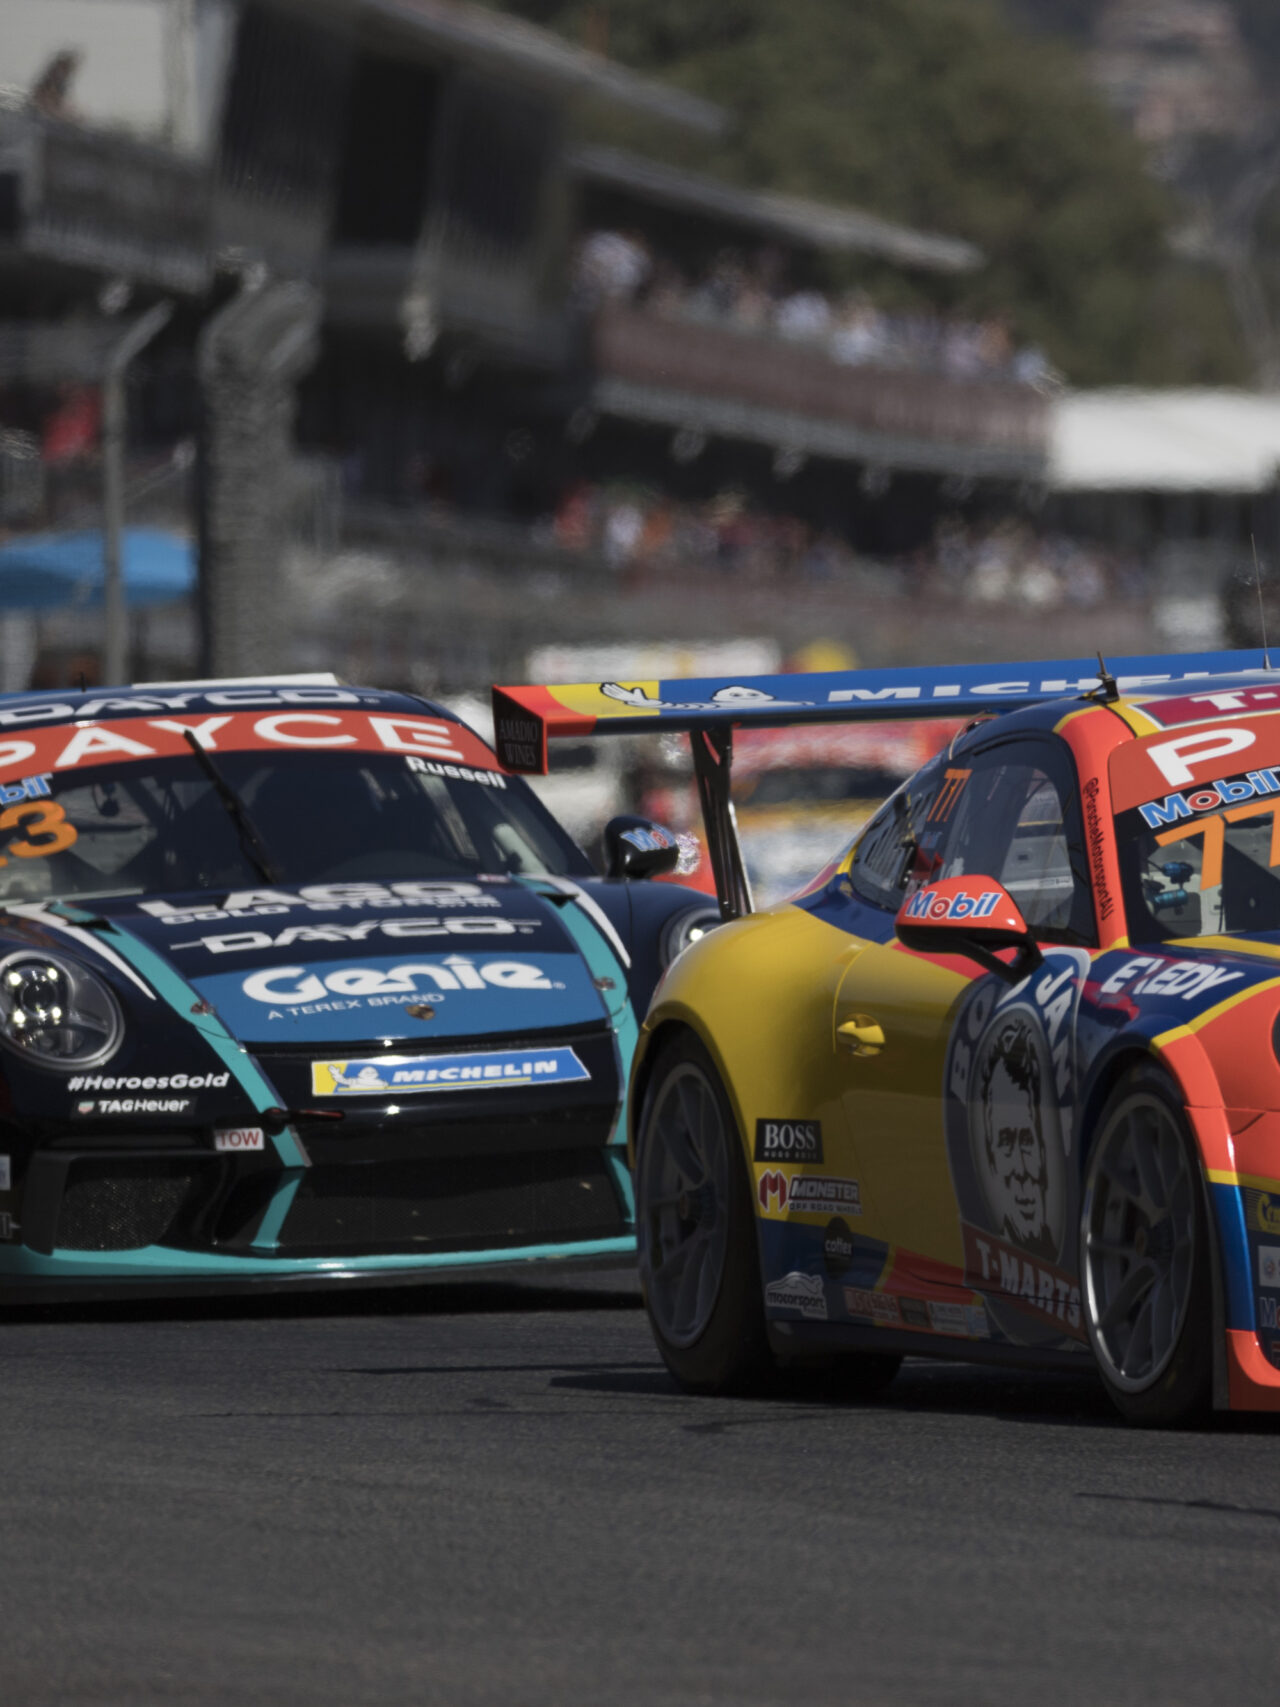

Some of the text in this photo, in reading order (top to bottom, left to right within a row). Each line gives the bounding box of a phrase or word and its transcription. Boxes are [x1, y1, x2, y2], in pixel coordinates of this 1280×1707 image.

[0, 688, 361, 725] DAYCO
[503, 743, 537, 766] WINES
[0, 772, 54, 806] bil
[405, 755, 507, 789] Russell
[0, 799, 78, 867] 3
[137, 881, 484, 917] LAGO
[905, 890, 1004, 919] Mobil
[202, 916, 516, 954] DAYCO
[243, 953, 553, 1005] Genie
[1100, 956, 1246, 1000] EXEDY
[267, 992, 446, 1021] A TEREX BRAND
[67, 1072, 230, 1092] #HeroesGold
[392, 1058, 558, 1083] MICHELIN
[219, 1131, 260, 1147] TOW
[764, 1123, 816, 1149] BOSS
[791, 1179, 859, 1201] MONSTER
[976, 1237, 1081, 1329] T-MARTS
